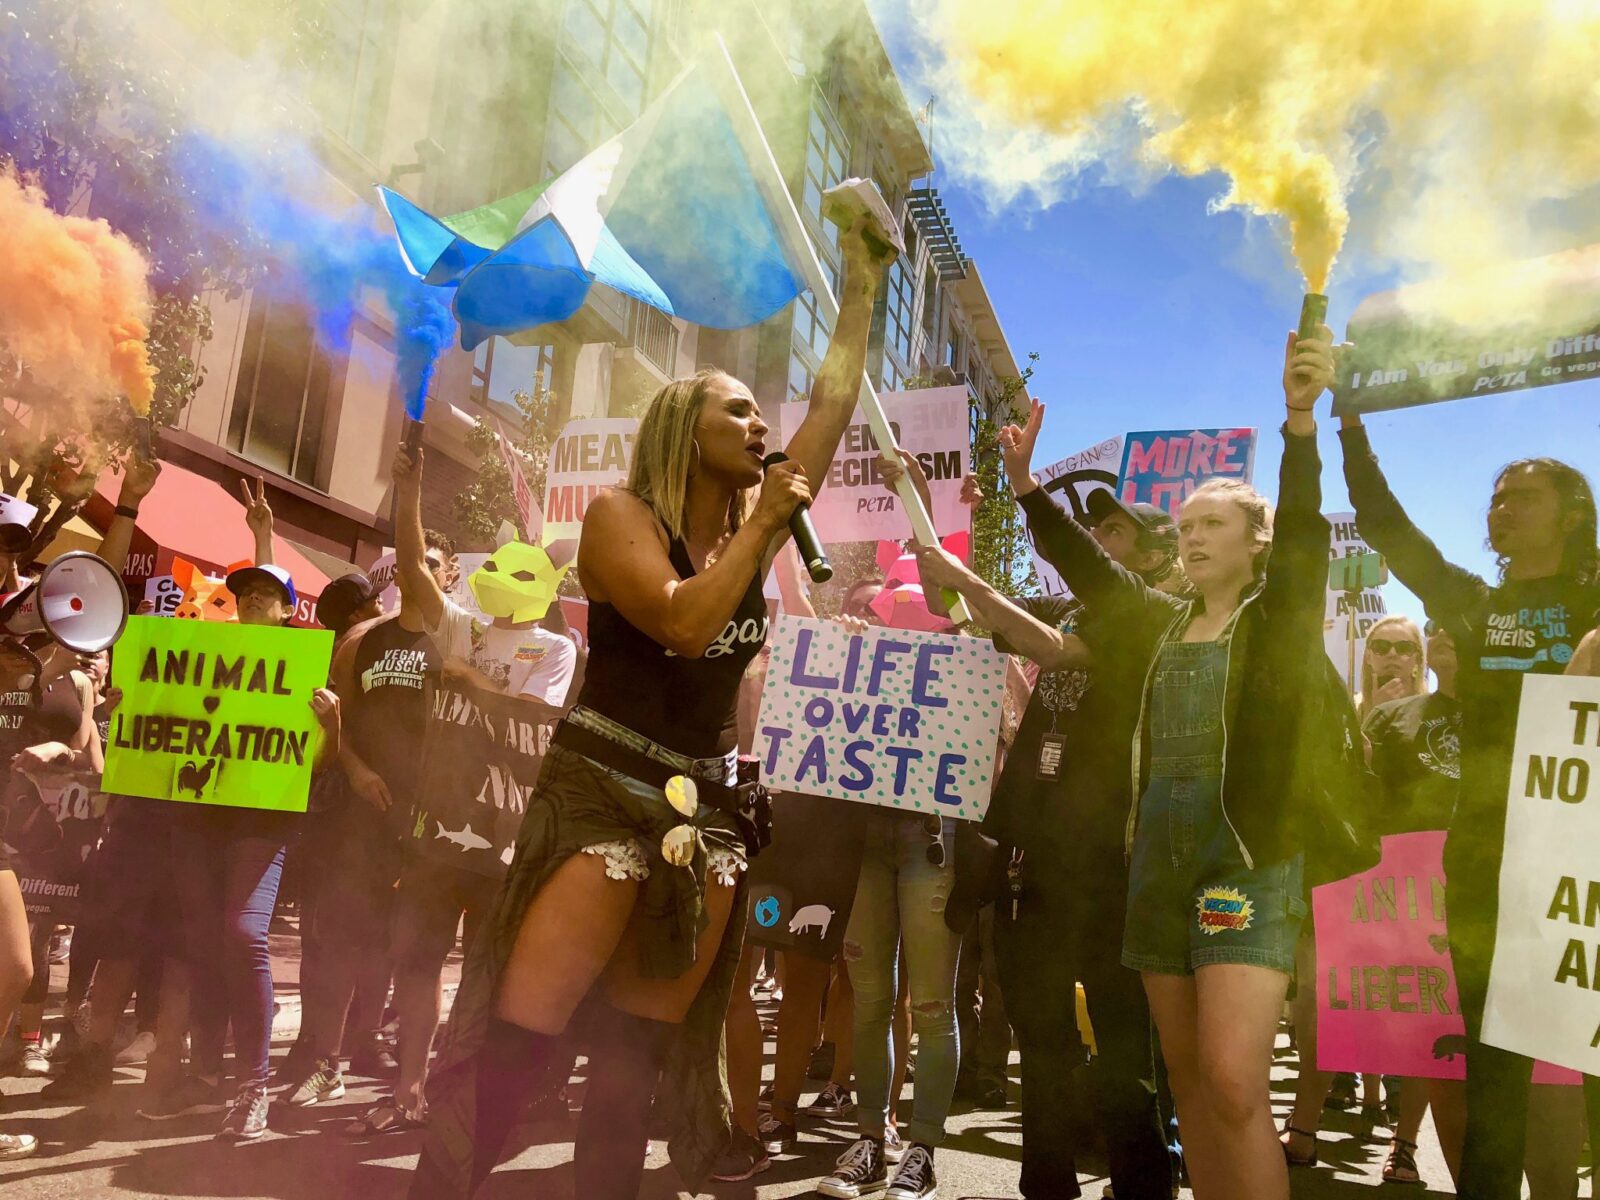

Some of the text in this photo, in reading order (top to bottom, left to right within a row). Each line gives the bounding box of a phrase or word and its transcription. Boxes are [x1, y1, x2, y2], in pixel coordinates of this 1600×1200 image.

[1366, 367, 1408, 388] Am
[1477, 346, 1536, 371] Only
[1544, 334, 1600, 359] Diff
[1541, 366, 1562, 377] Go
[1567, 361, 1600, 373] veg
[1124, 429, 1251, 479] MORE
[122, 553, 154, 577] APAS
[140, 646, 292, 696] ANIMAL
[372, 659, 429, 674] MUSCLE
[384, 649, 425, 662] VEGAN
[790, 628, 954, 708] LIFE
[372, 677, 423, 690] NOT ANIMALS
[113, 713, 310, 767] LIBERATION
[804, 697, 921, 738] OVER
[761, 726, 967, 806] TASTE
[1525, 755, 1590, 804] NO
[20, 878, 80, 897] Different
[1203, 898, 1242, 914] VEGAN
[1327, 965, 1462, 1016] LIBER
